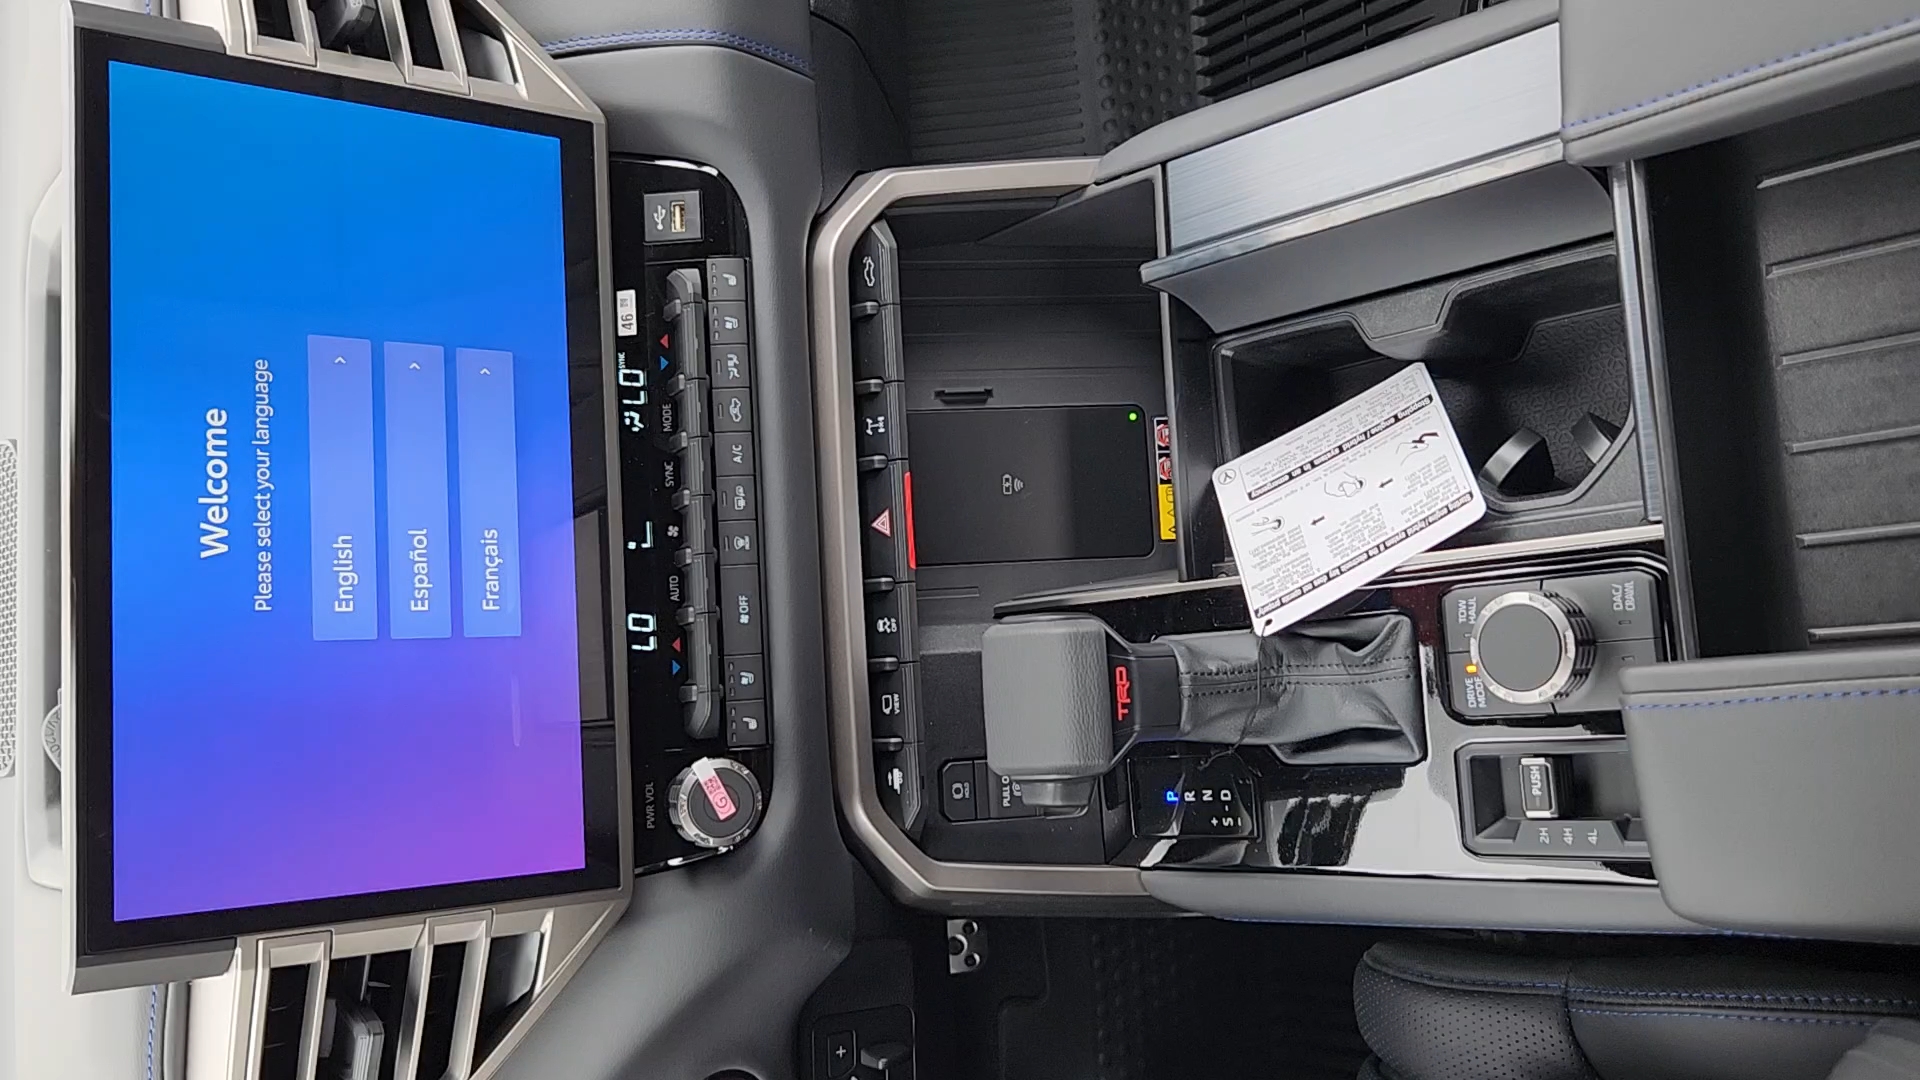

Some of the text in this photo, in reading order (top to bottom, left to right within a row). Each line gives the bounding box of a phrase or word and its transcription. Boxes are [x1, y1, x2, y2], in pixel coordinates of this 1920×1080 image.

[620, 313, 634, 330] 46
[618, 352, 645, 405] LO SYNC
[662, 403, 672, 432] MODE
[1396, 396, 1430, 418] Stopping
[1369, 415, 1395, 434] engine
[732, 444, 743, 463] A/C
[1341, 432, 1365, 450] hybrid
[1312, 445, 1339, 465] system
[198, 408, 229, 558] Welcome
[252, 359, 275, 612] Please select your language
[664, 461, 675, 487] SYNC
[1250, 472, 1289, 498] emergency
[333, 535, 358, 613] English
[408, 528, 433, 612] Español
[481, 529, 503, 611] Français
[669, 575, 680, 602] AUTO
[1612, 584, 1624, 611] DAC/
[1624, 580, 1636, 611] CRAWL
[738, 595, 749, 613] OFF
[1458, 599, 1467, 624] TOW
[1467, 596, 1477, 624] HAUL
[627, 613, 654, 651] LO
[892, 693, 900, 715] VIEW
[1115, 666, 1131, 721] TRD
[1465, 677, 1477, 708] DRIVE
[1474, 676, 1487, 707] MODE
[1001, 775, 1011, 807] PULL O
[1529, 765, 1542, 796] PUSH
[644, 782, 656, 829] PWR VOL
[715, 796, 728, 809] G
[1166, 790, 1179, 802] P
[1184, 790, 1196, 802] R
[1202, 789, 1213, 801] N
[1220, 789, 1234, 827] S D
[1539, 827, 1550, 845] 2H
[1563, 827, 1574, 846] 4H
[1588, 829, 1598, 846] 4L
